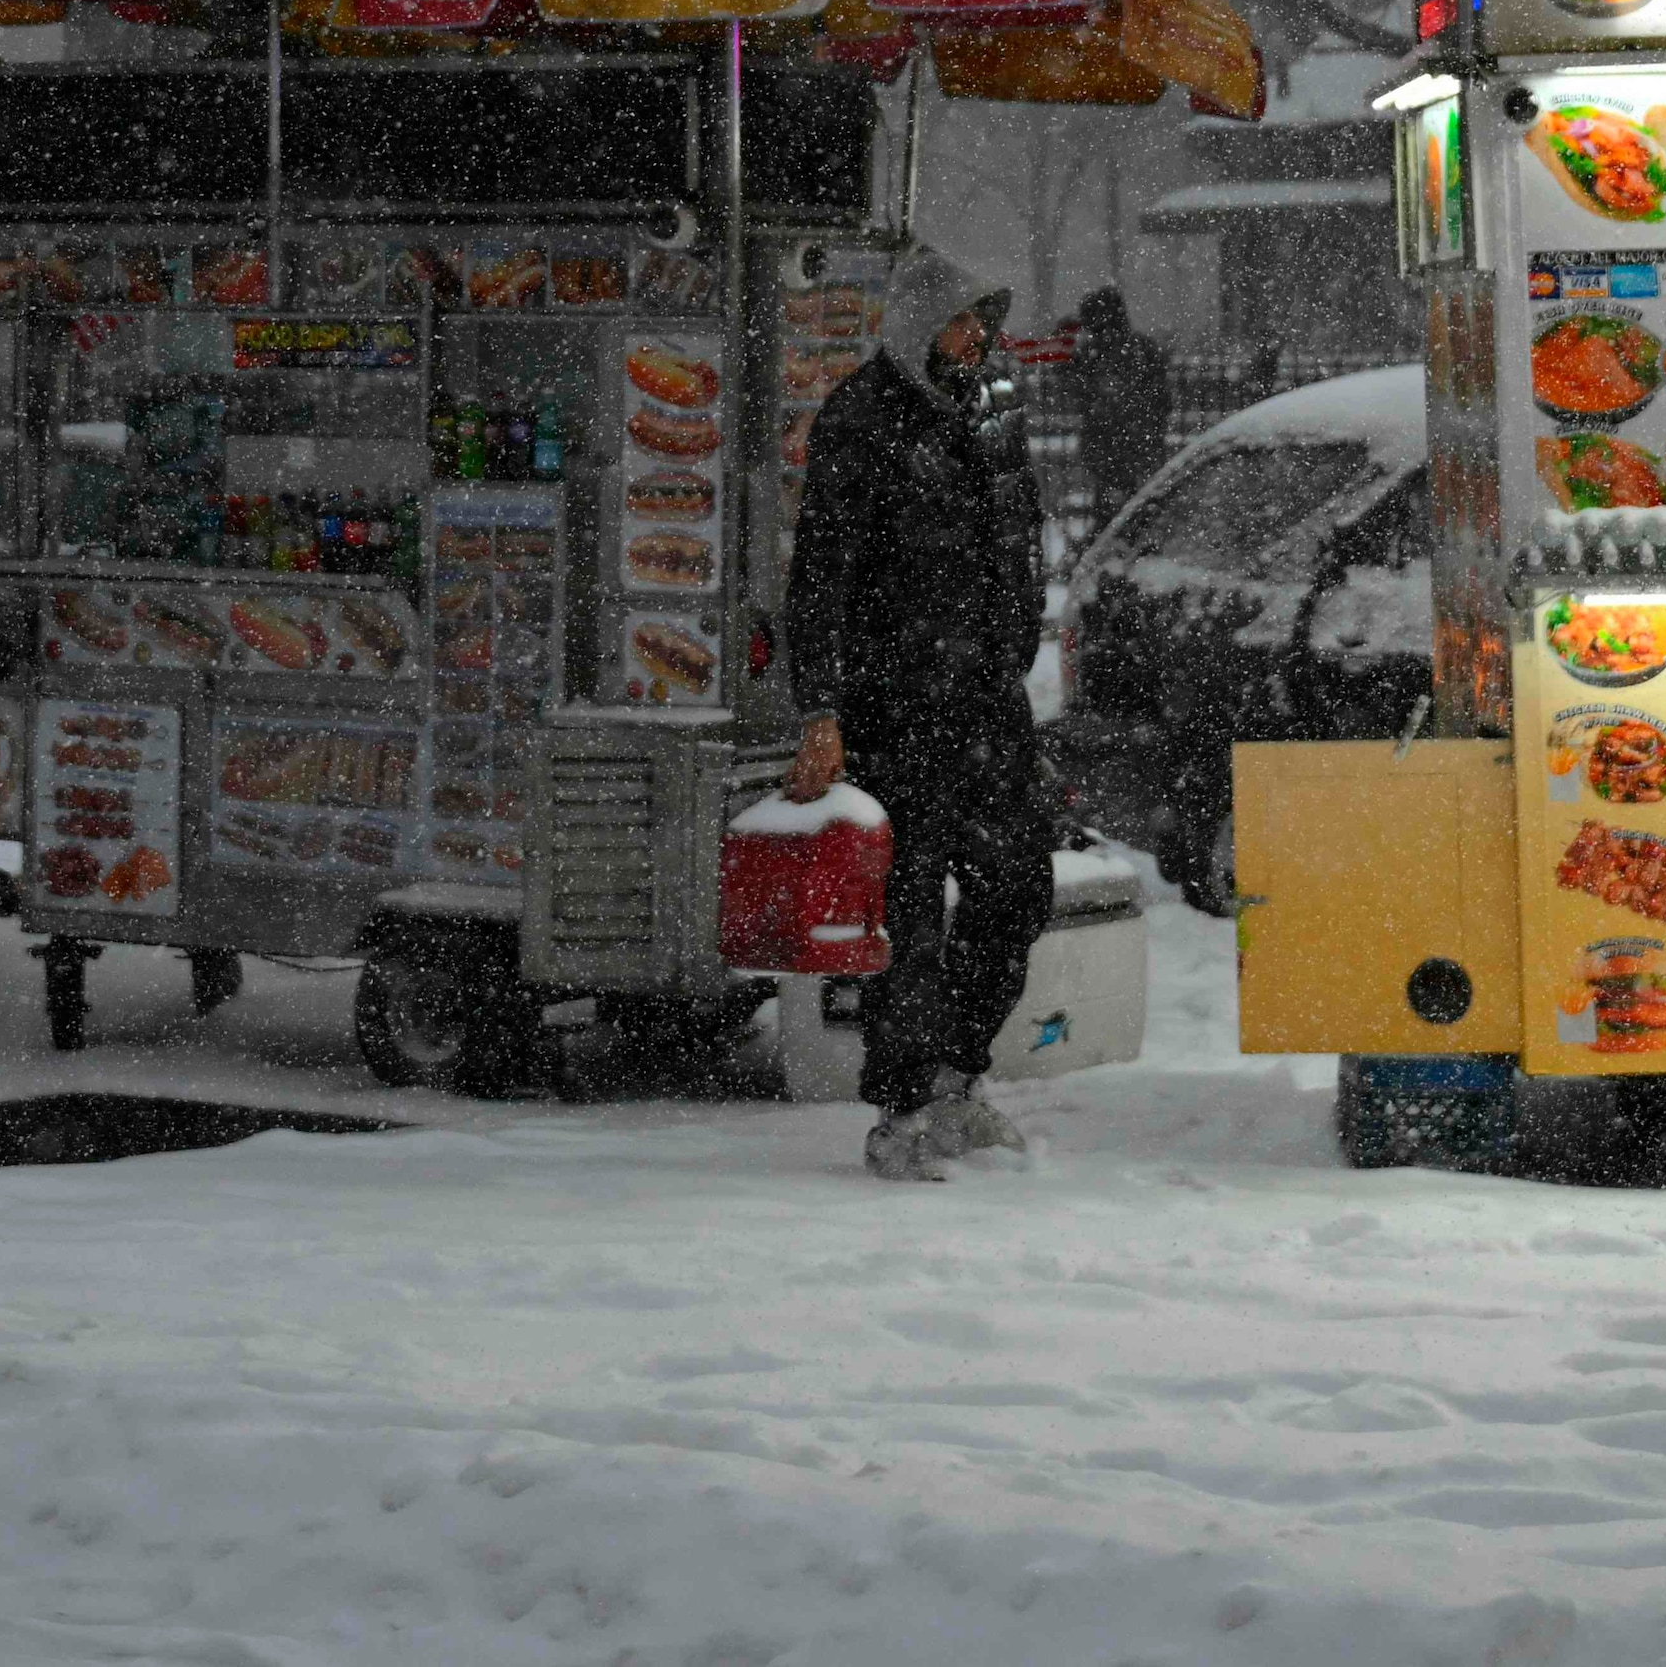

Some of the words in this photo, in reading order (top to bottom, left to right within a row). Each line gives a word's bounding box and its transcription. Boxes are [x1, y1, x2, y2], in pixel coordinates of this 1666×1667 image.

[1615, 251, 1656, 263] MAJOR
[1569, 275, 1602, 289] VISA
[1554, 703, 1607, 722] CHICKEN
